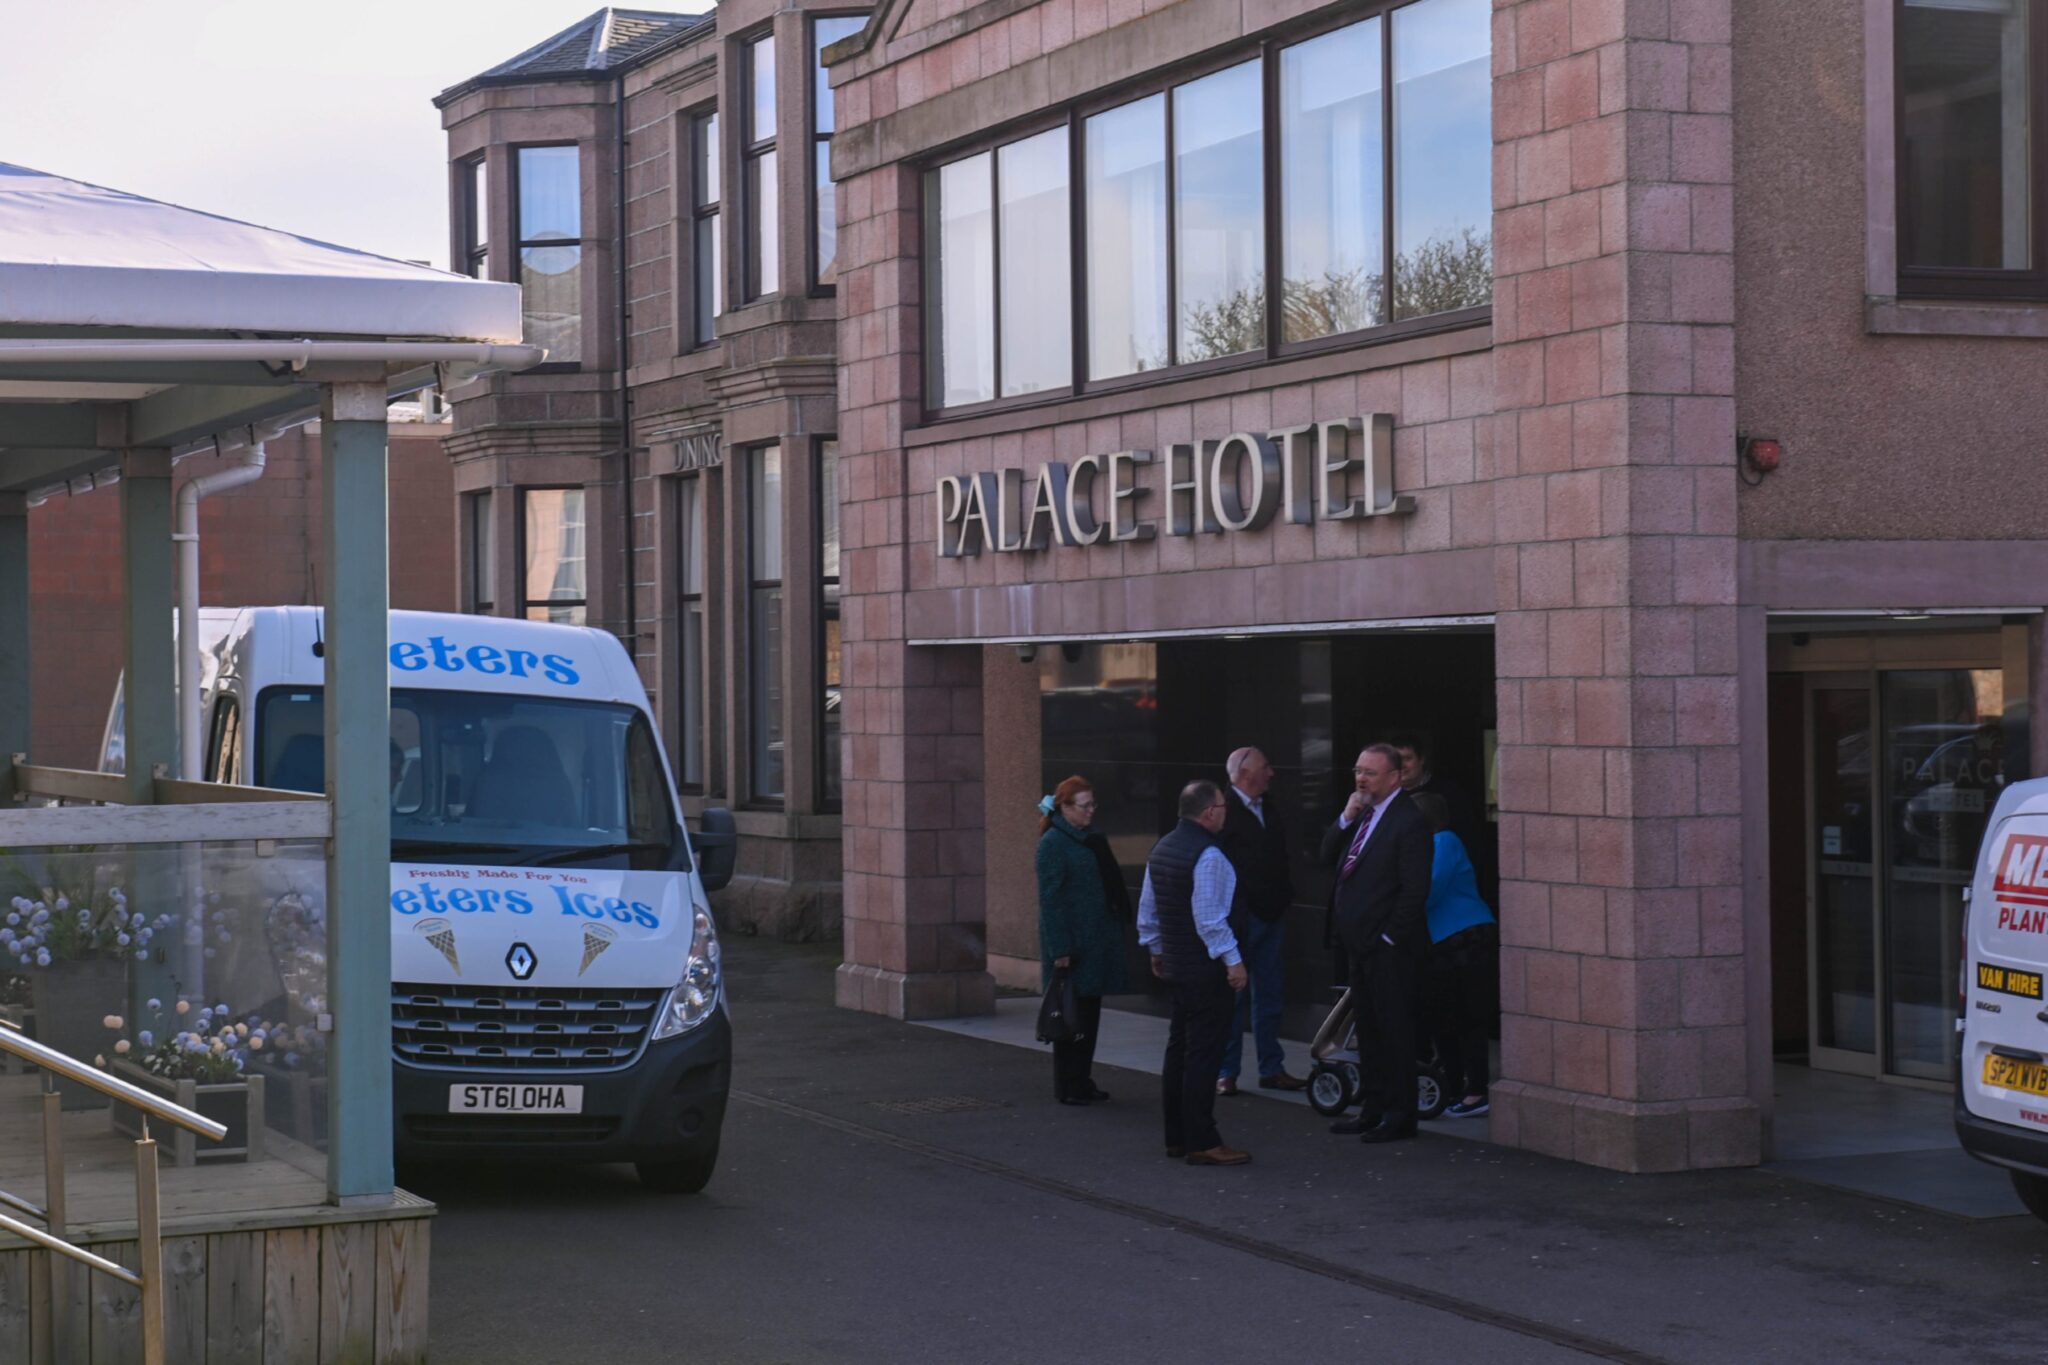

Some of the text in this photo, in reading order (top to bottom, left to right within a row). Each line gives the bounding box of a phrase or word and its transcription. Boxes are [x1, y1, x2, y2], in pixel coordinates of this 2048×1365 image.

[936, 413, 1413, 557] PALACE HOTEL
[389, 636, 580, 685] eters
[408, 869, 588, 884] Freshly Made For You
[390, 882, 659, 929] eters Ices
[1997, 906, 2048, 934] PLAN
[1979, 966, 2040, 996] VAN HIRE
